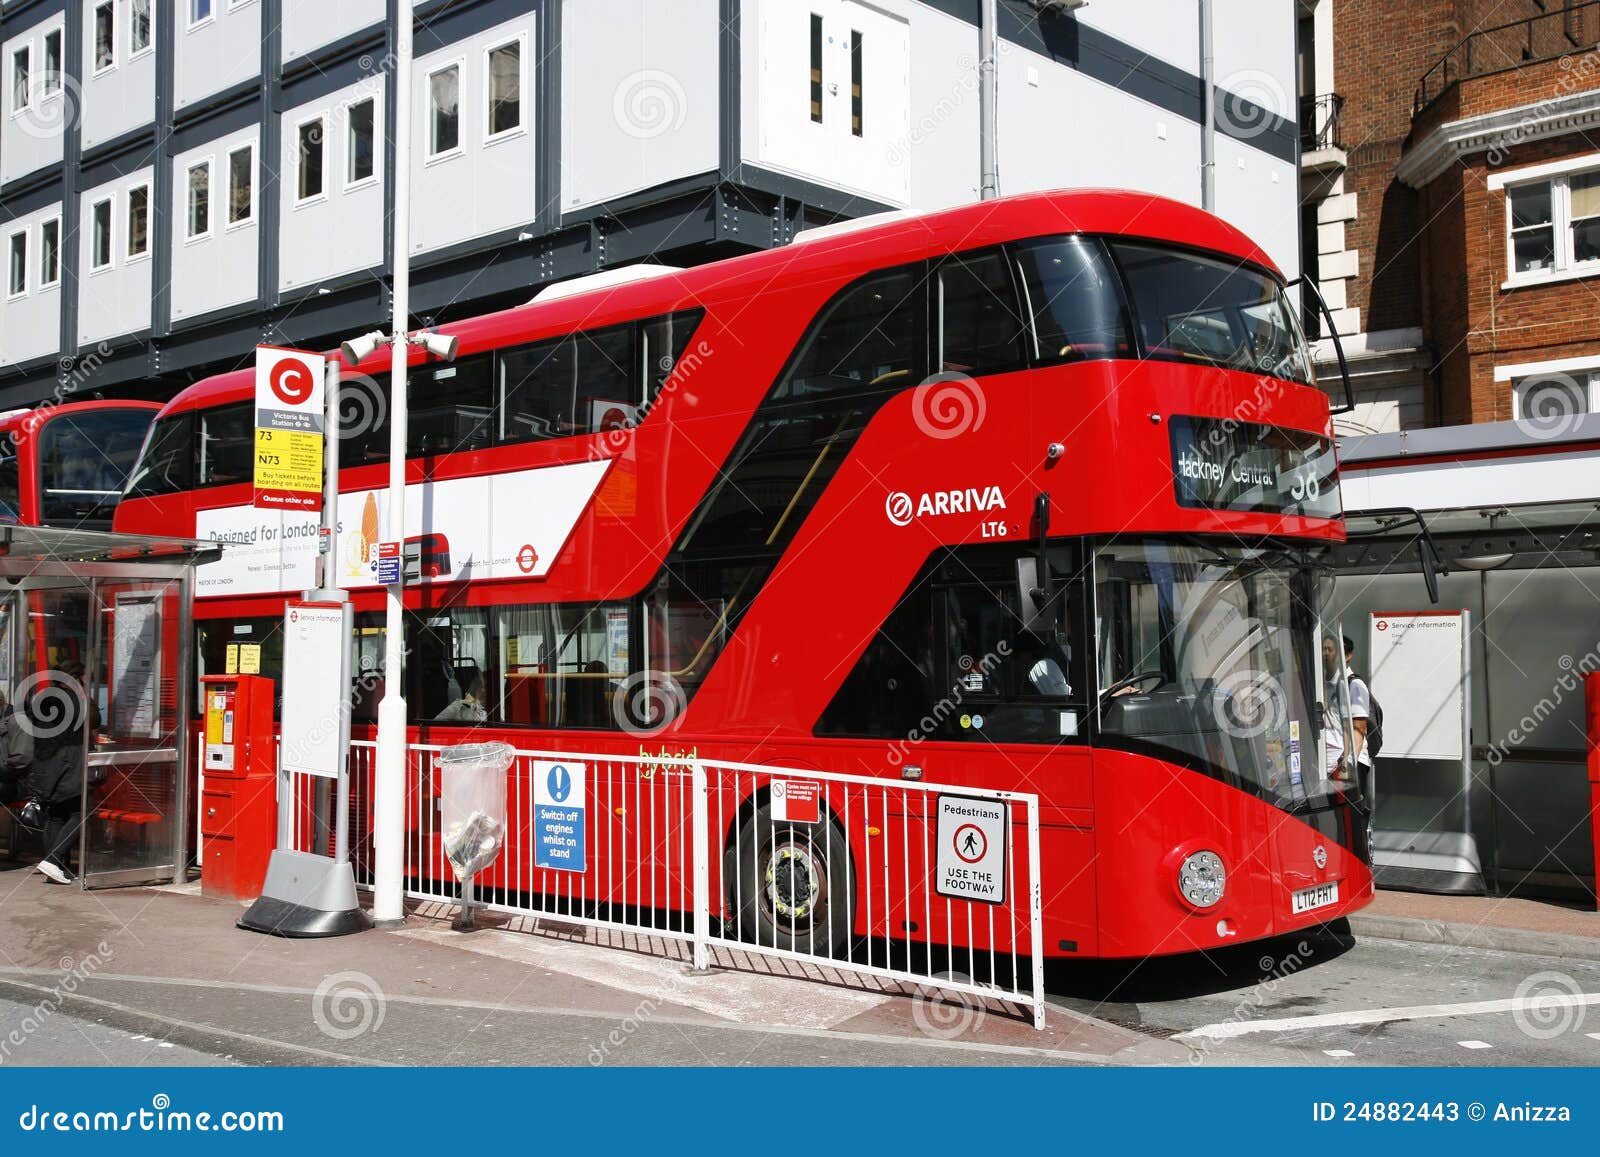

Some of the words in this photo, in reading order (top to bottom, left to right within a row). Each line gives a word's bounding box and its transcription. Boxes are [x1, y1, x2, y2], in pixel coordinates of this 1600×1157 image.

[279, 369, 301, 397] C
[273, 412, 298, 420] Victoria
[271, 419, 294, 428] Station
[259, 430, 272, 441] 73
[258, 454, 280, 465] N73
[263, 495, 284, 503] Queue
[916, 486, 1006, 517] ARRIVA
[260, 525, 278, 540] for
[982, 521, 1007, 538] LT6
[540, 808, 565, 821] Switch
[566, 811, 578, 822] off
[944, 804, 1000, 820] Pedestrians
[546, 823, 574, 834] engines
[543, 834, 566, 846] whilst
[566, 837, 576, 846] on
[550, 848, 570, 858] stand
[948, 868, 969, 879] USE
[972, 871, 992, 882] THE
[945, 878, 995, 894] FOOTWAY
[1297, 890, 1316, 910] LT12
[1317, 884, 1332, 905] FHT
